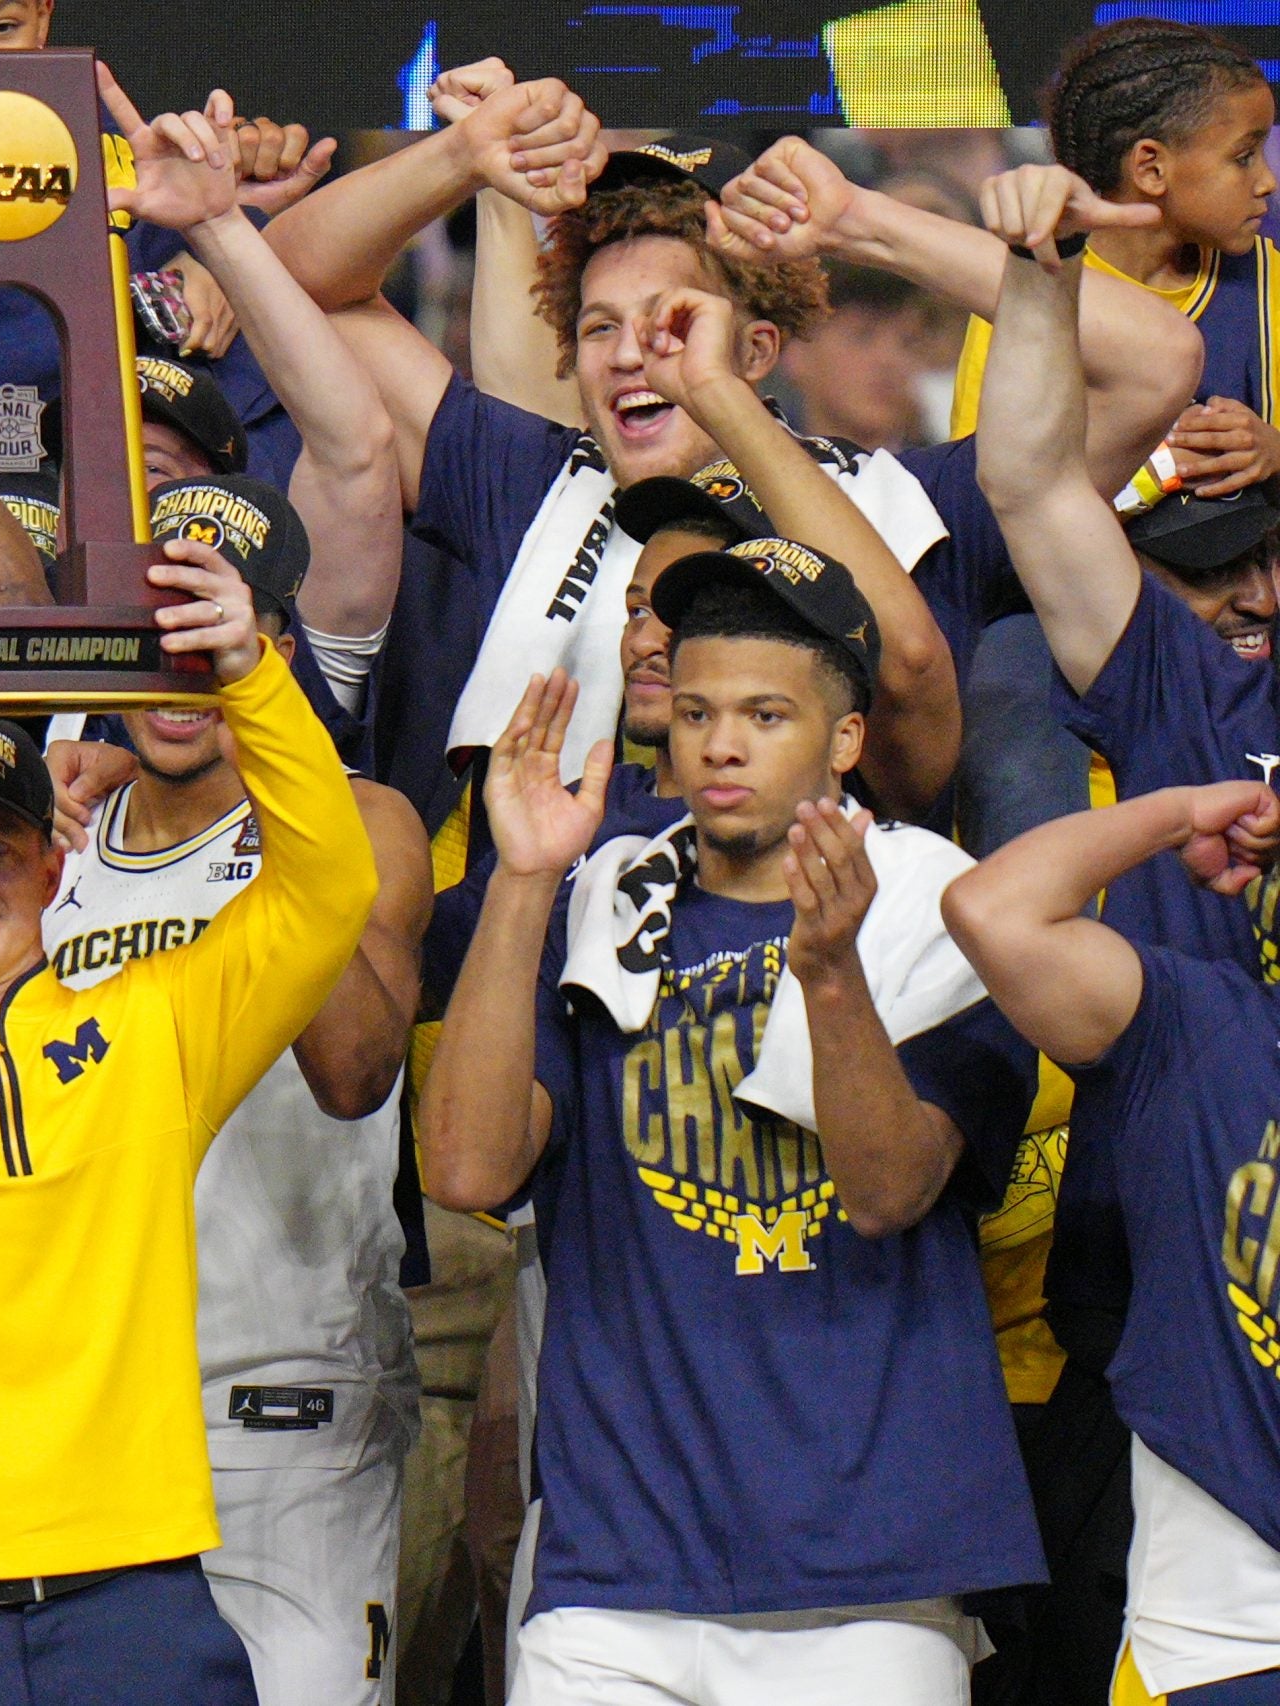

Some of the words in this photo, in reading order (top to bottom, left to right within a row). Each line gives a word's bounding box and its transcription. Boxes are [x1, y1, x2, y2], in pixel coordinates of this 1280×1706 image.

[150, 491, 267, 550] CHAMPIONS
[26, 637, 140, 661] CHAMPION
[42, 1016, 111, 1085] M
[306, 1399, 325, 1411] 46
